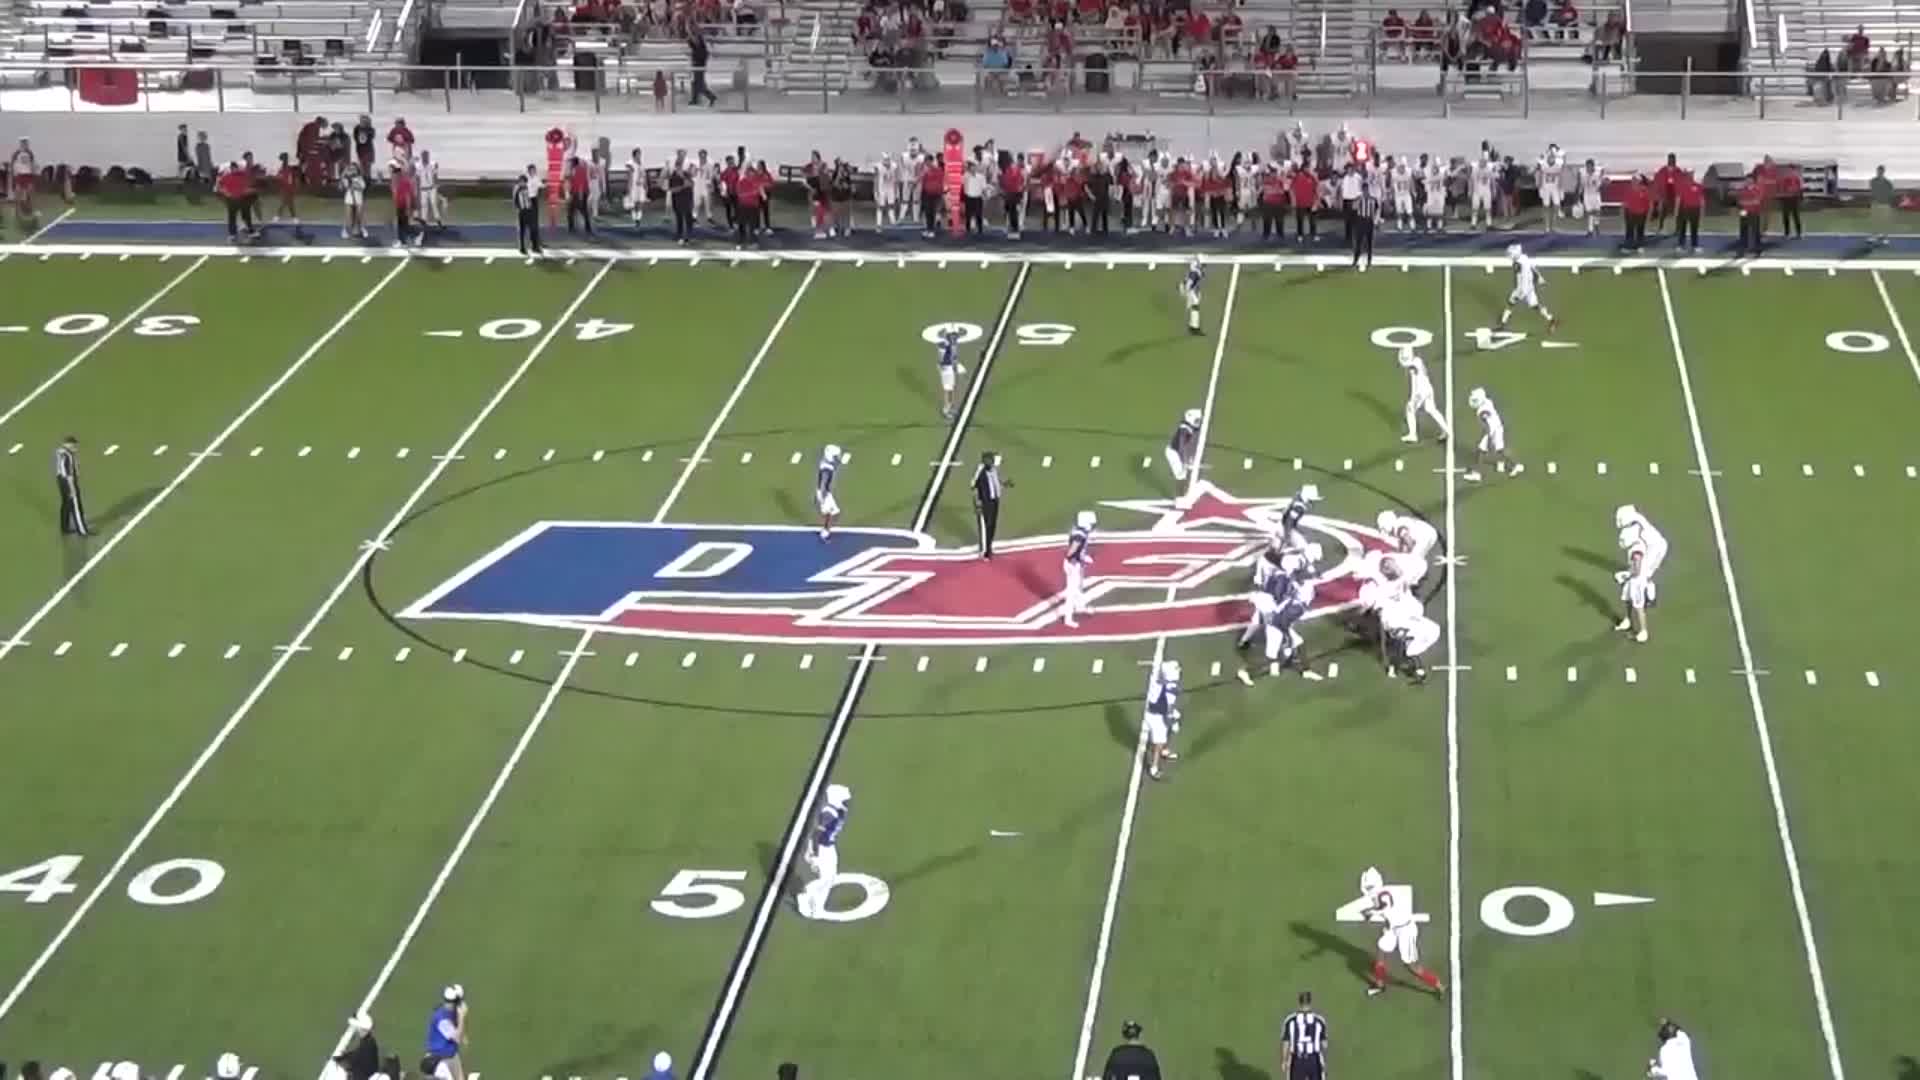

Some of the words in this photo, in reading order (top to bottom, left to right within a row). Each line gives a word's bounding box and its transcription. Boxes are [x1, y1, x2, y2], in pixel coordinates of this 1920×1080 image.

[44, 313, 200, 335] 30
[479, 318, 634, 340] 40
[921, 322, 1077, 345] 50
[1370, 327, 1527, 349] 40
[0, 855, 225, 904] 40
[650, 870, 890, 920] 50
[1299, 1023, 1312, 1042] L
